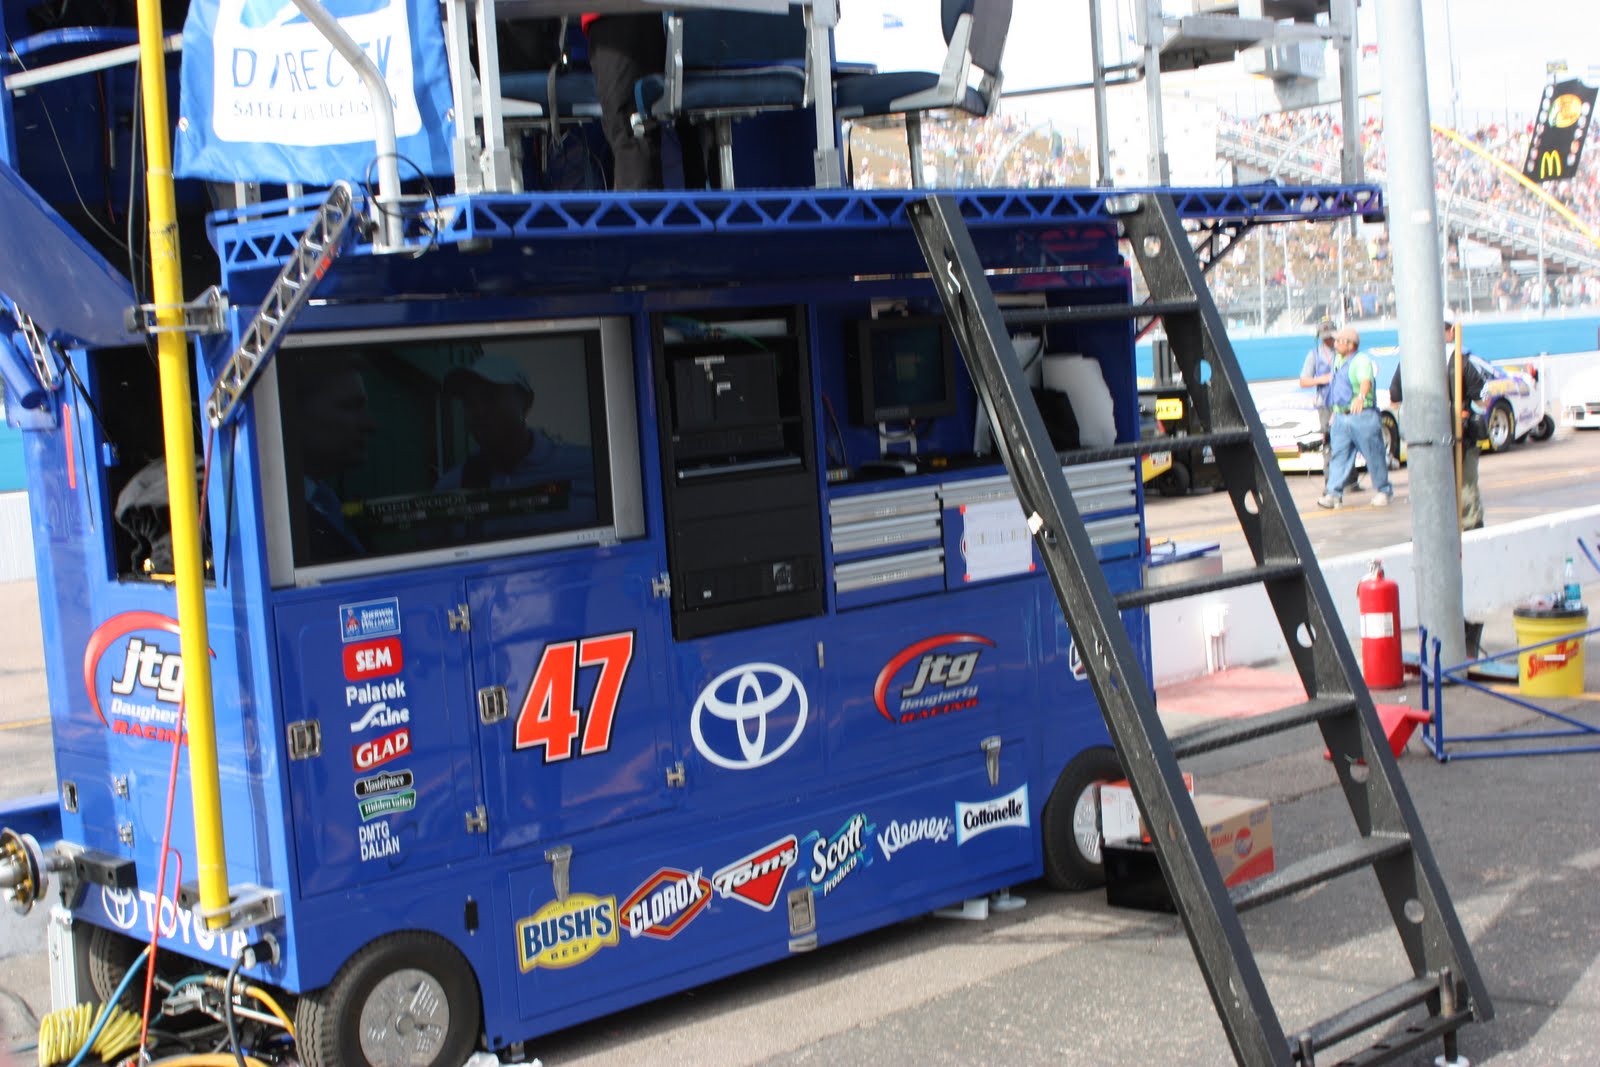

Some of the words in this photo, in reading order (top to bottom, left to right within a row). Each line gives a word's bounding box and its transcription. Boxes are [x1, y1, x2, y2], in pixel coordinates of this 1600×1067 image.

[111, 637, 184, 704] jtg
[355, 646, 392, 673] SEM
[902, 650, 981, 699] jtg
[346, 678, 406, 707] Palatek
[513, 628, 637, 767] 47
[111, 698, 188, 727] Daugher
[356, 732, 409, 768] GLAD
[364, 774, 405, 795] Masterpiece
[364, 800, 392, 815] Hidden
[391, 796, 413, 809] Valley
[963, 798, 1023, 830] Cottonelle
[359, 820, 390, 844] DMTG
[361, 835, 400, 862] DALIAN
[810, 813, 865, 884] Scott
[877, 815, 950, 862] Kleenex
[713, 847, 796, 895] Tom's
[629, 867, 703, 938] CLOROX
[523, 903, 613, 961] BUSH'S
